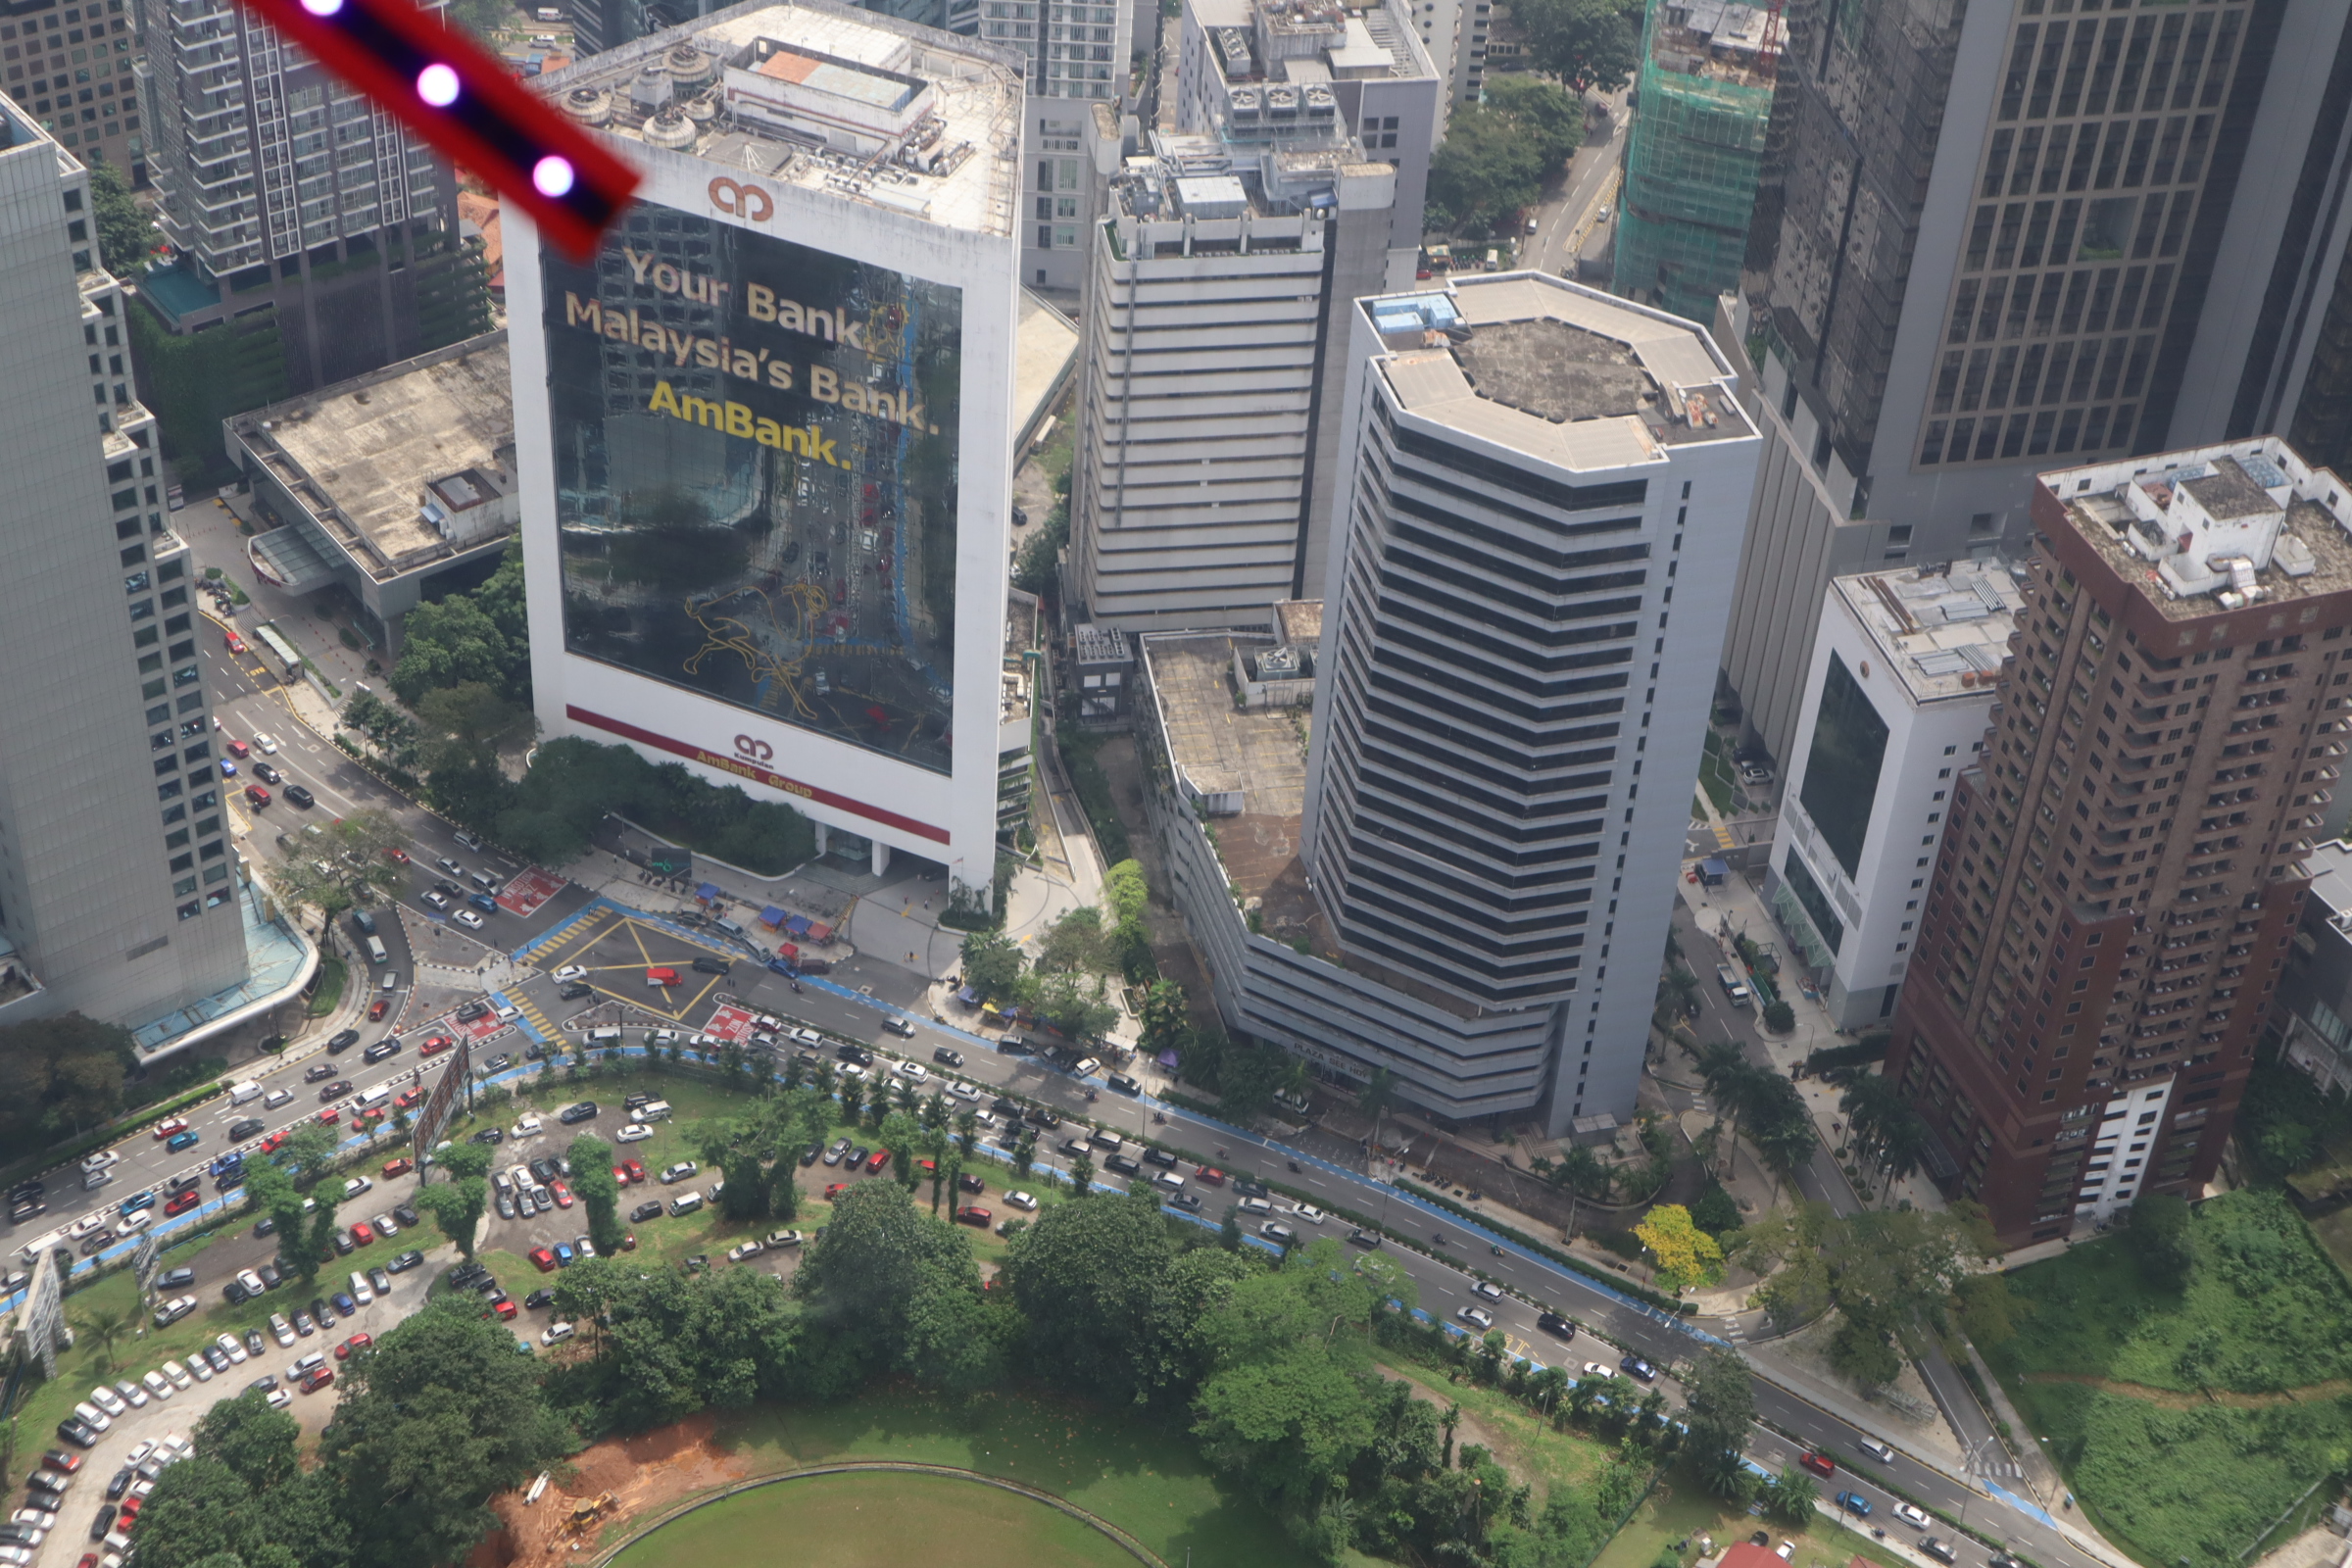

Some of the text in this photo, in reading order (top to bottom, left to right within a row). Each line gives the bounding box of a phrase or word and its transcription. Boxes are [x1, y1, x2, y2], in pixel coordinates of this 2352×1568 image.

[622, 247, 729, 307] Your
[564, 290, 940, 435] Malaysia's Bank.
[648, 380, 852, 470] AmBank.
[697, 751, 812, 798] AmBank Group
[734, 752, 774, 770] Kumpulan
[1295, 1042, 1324, 1061] PLAZA
[1329, 1057, 1346, 1070] SEE
